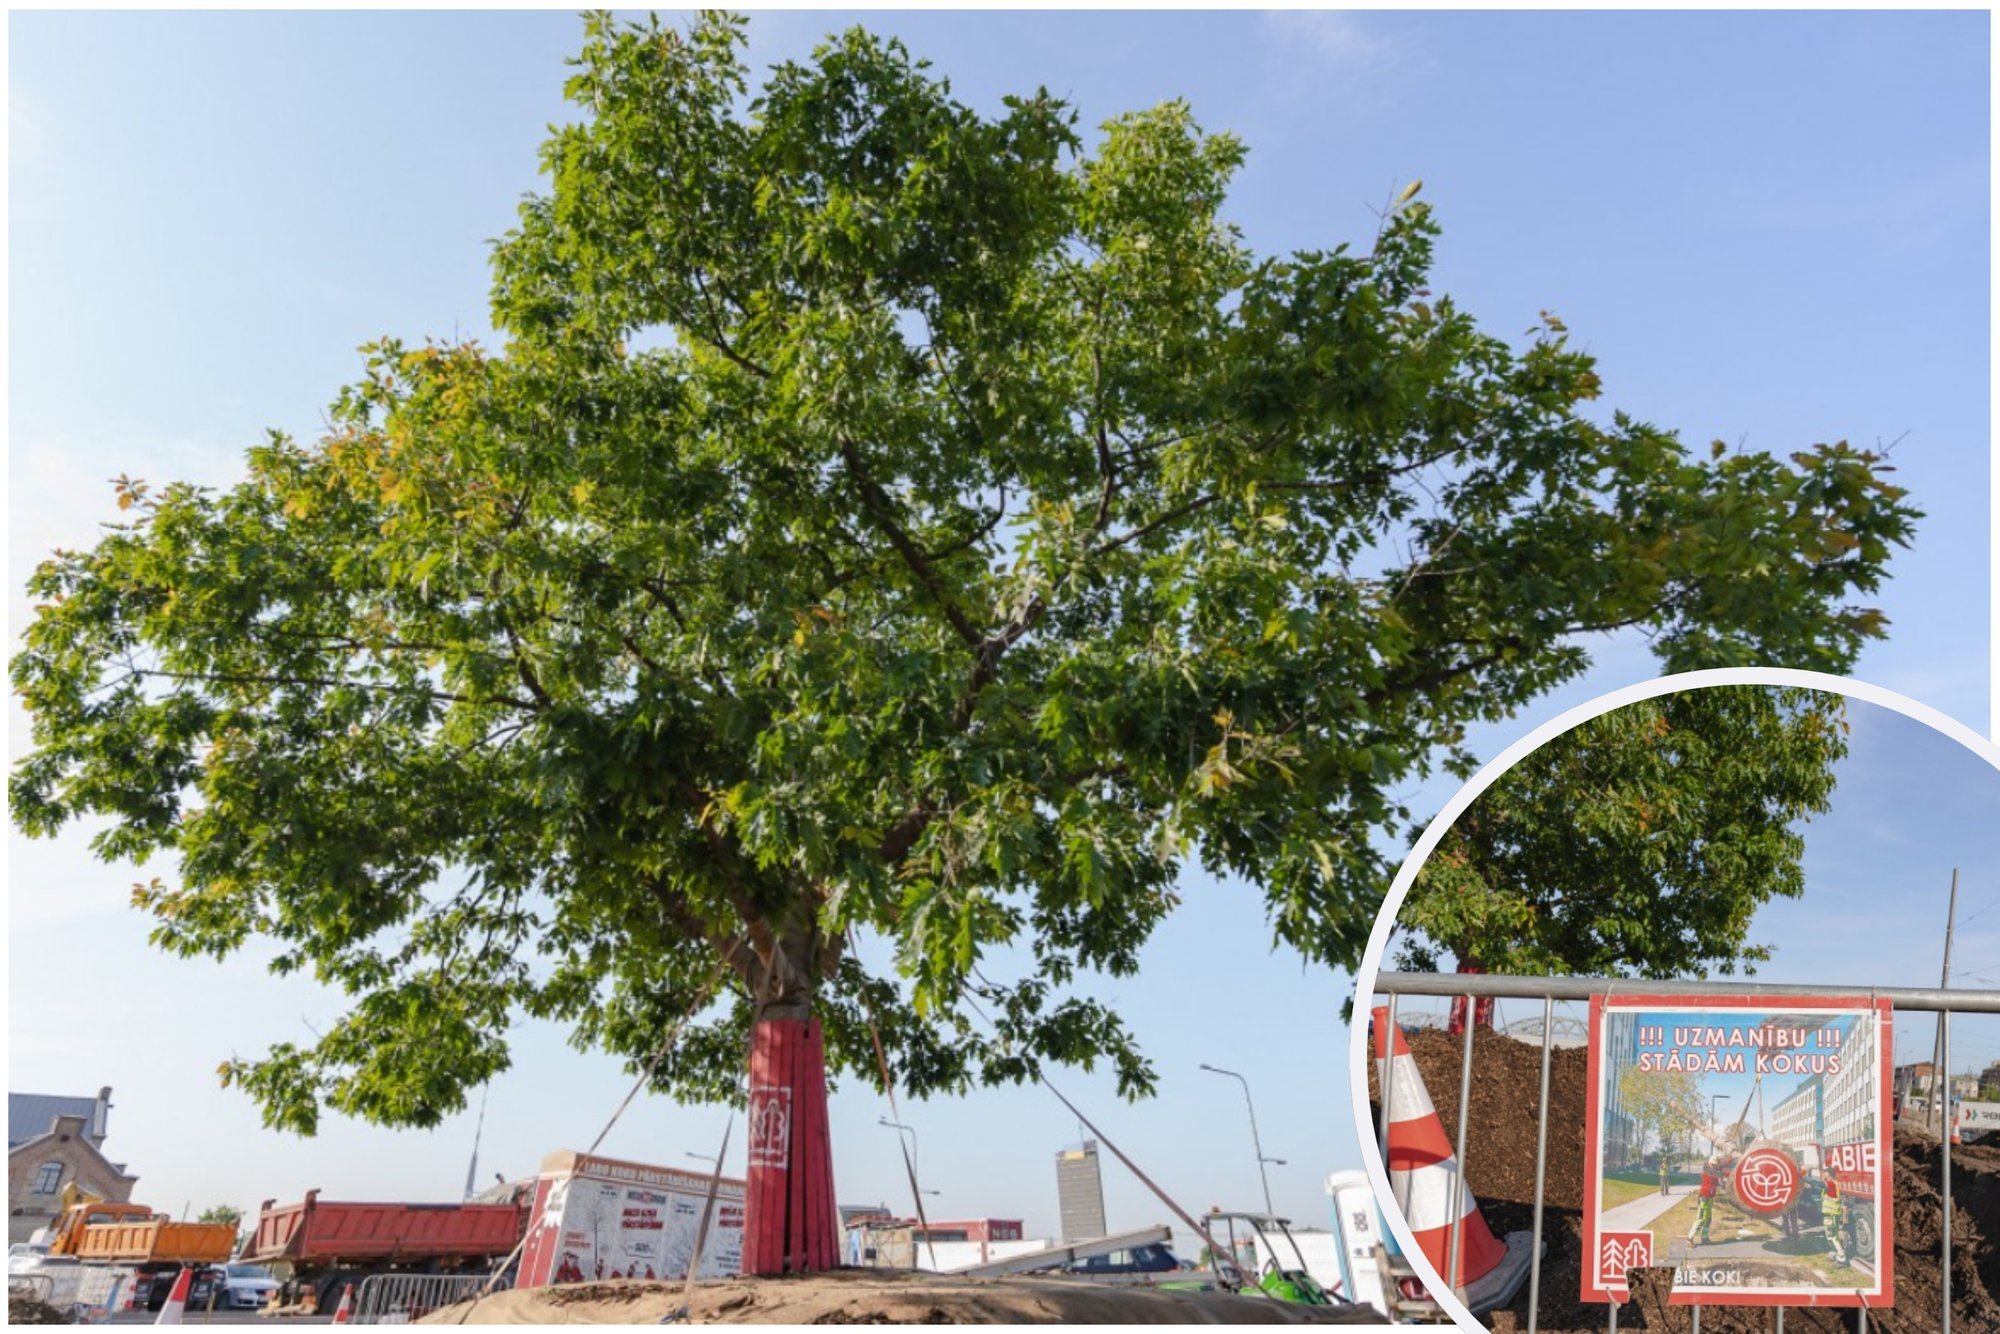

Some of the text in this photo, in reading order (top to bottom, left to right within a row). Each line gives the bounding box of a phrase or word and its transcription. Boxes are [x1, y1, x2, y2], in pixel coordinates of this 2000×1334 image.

[1674, 1025, 1806, 1047] UZMANĪBU
[1639, 1049, 1841, 1074] STĀDĀM KOKUS
[1702, 1270, 1740, 1284] KOKI
